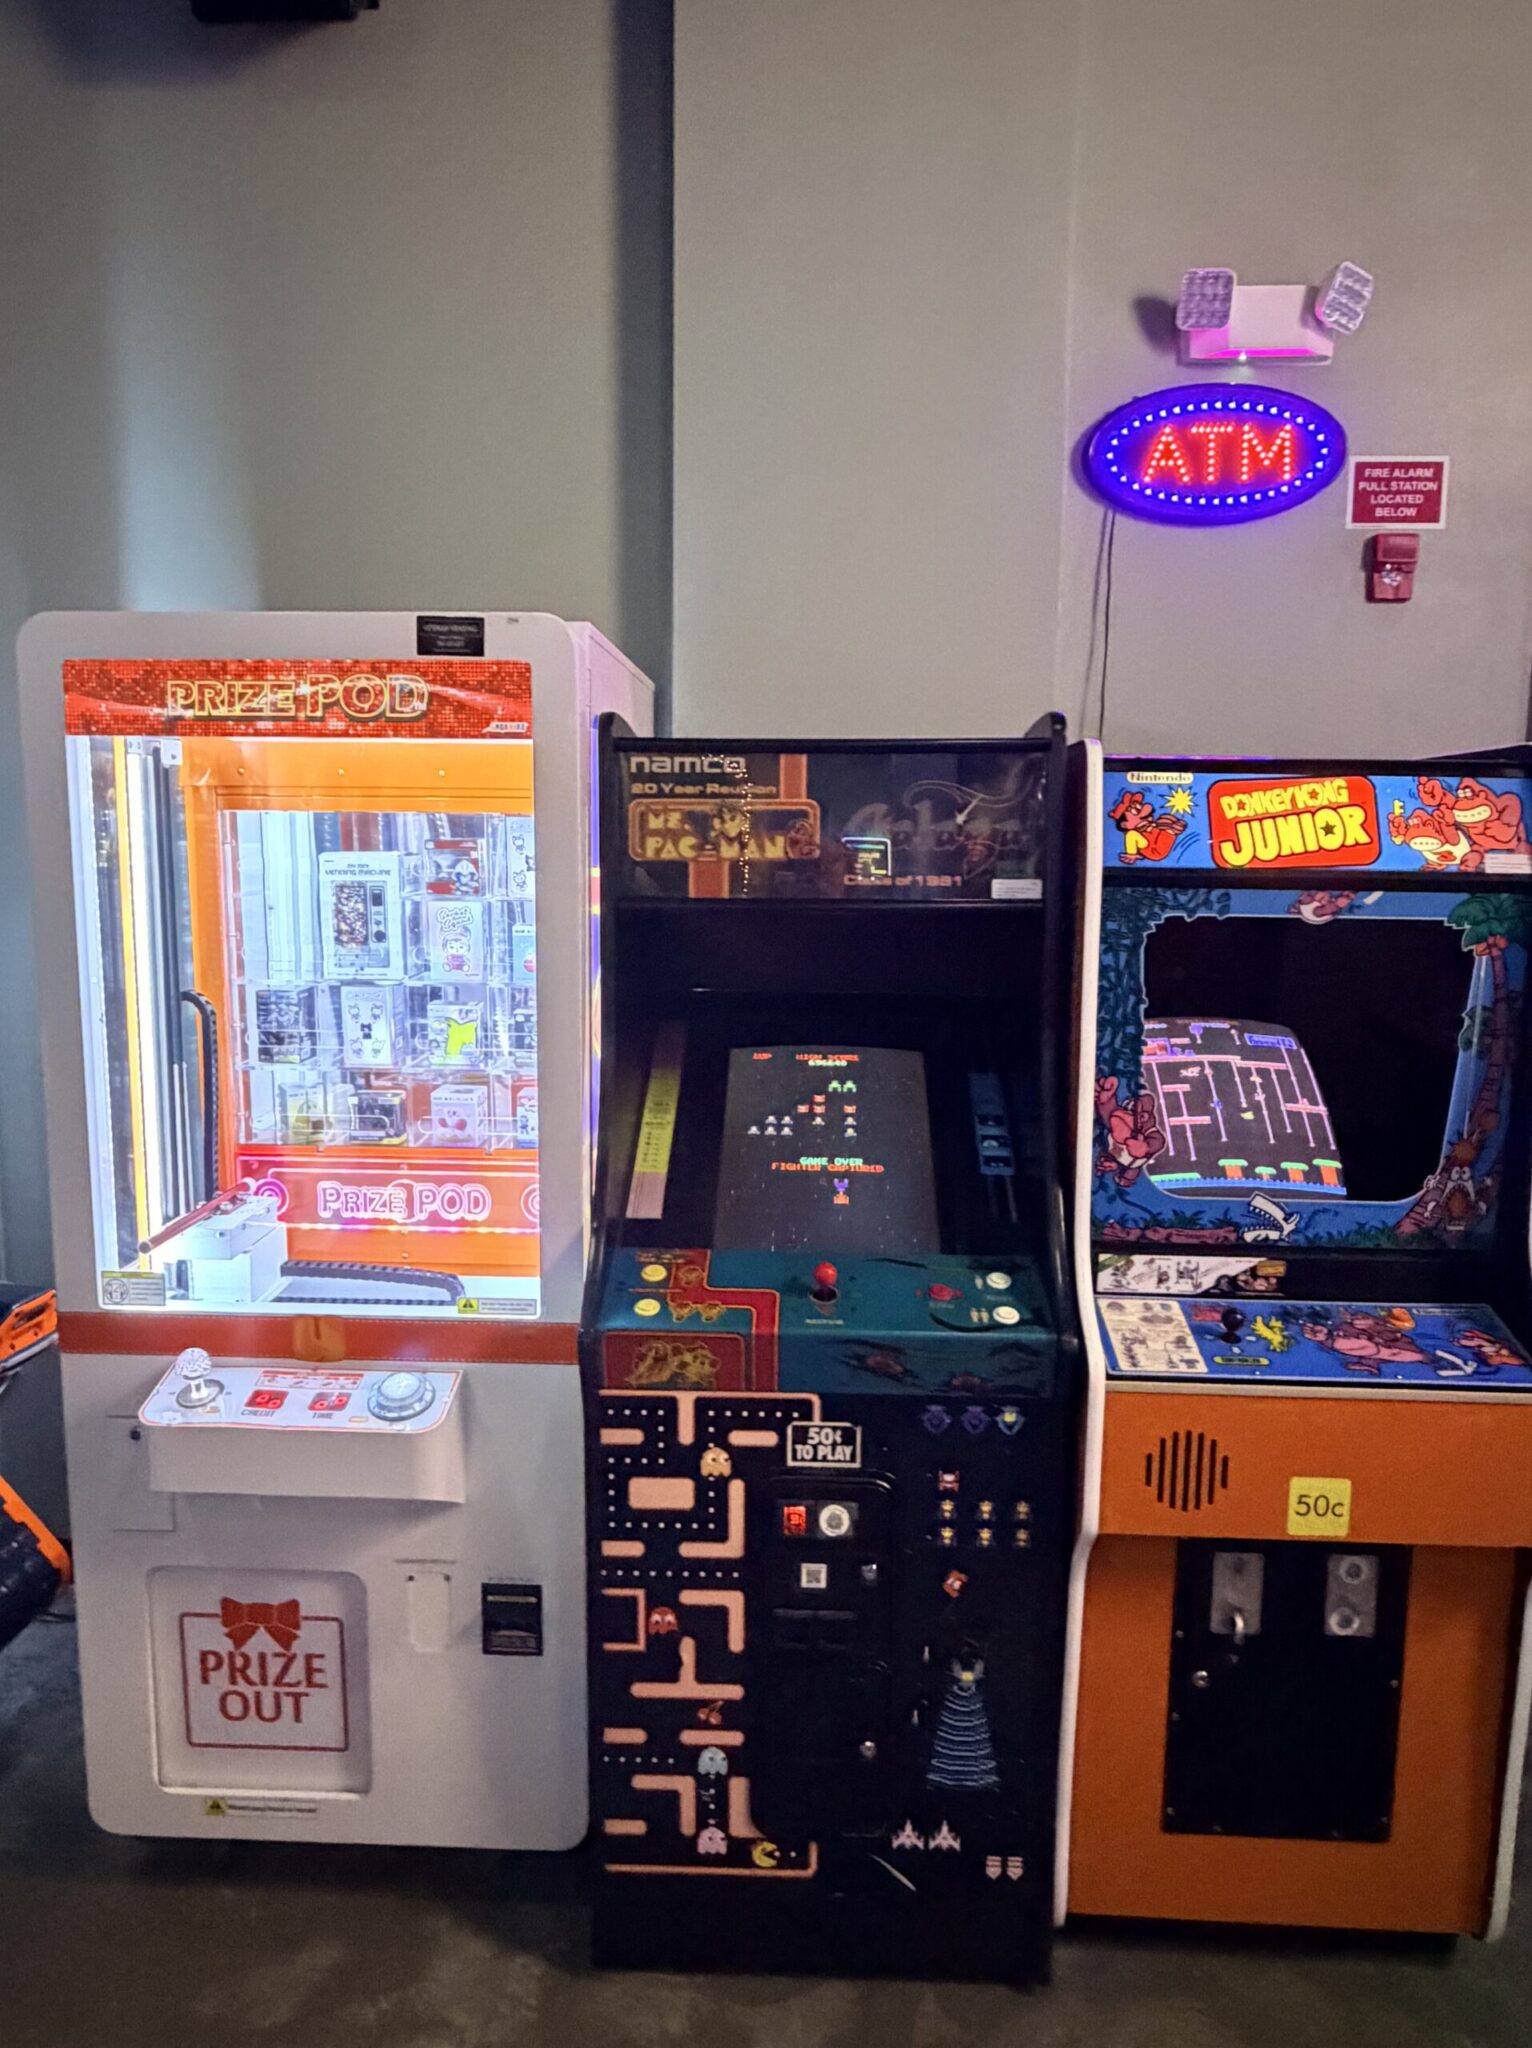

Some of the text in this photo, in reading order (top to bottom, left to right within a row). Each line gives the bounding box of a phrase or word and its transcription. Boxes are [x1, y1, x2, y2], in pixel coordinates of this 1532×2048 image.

[1142, 422, 1297, 484] ATM
[1364, 468, 1434, 478] FIRE ALARM
[1358, 481, 1438, 491] PULL STATION
[1370, 494, 1424, 504] LOCATED
[1375, 507, 1417, 517] BELOW
[167, 673, 429, 718] PRIZE POD
[630, 756, 746, 774] namco
[1130, 773, 1192, 782] Nintendo
[631, 783, 657, 794] 20
[660, 783, 703, 794] Year
[1219, 778, 1349, 820] DONKEY KONG
[1220, 805, 1373, 867] JUNIOR
[645, 835, 786, 859] PAC-MAN
[800, 1157, 828, 1165] GAME
[320, 1184, 489, 1217] PRIZE POD
[795, 1445, 853, 1462] TO PLAY
[1294, 1494, 1345, 1519] 50c
[200, 1649, 329, 1689] PRIZE
[219, 1690, 310, 1723] OUT
